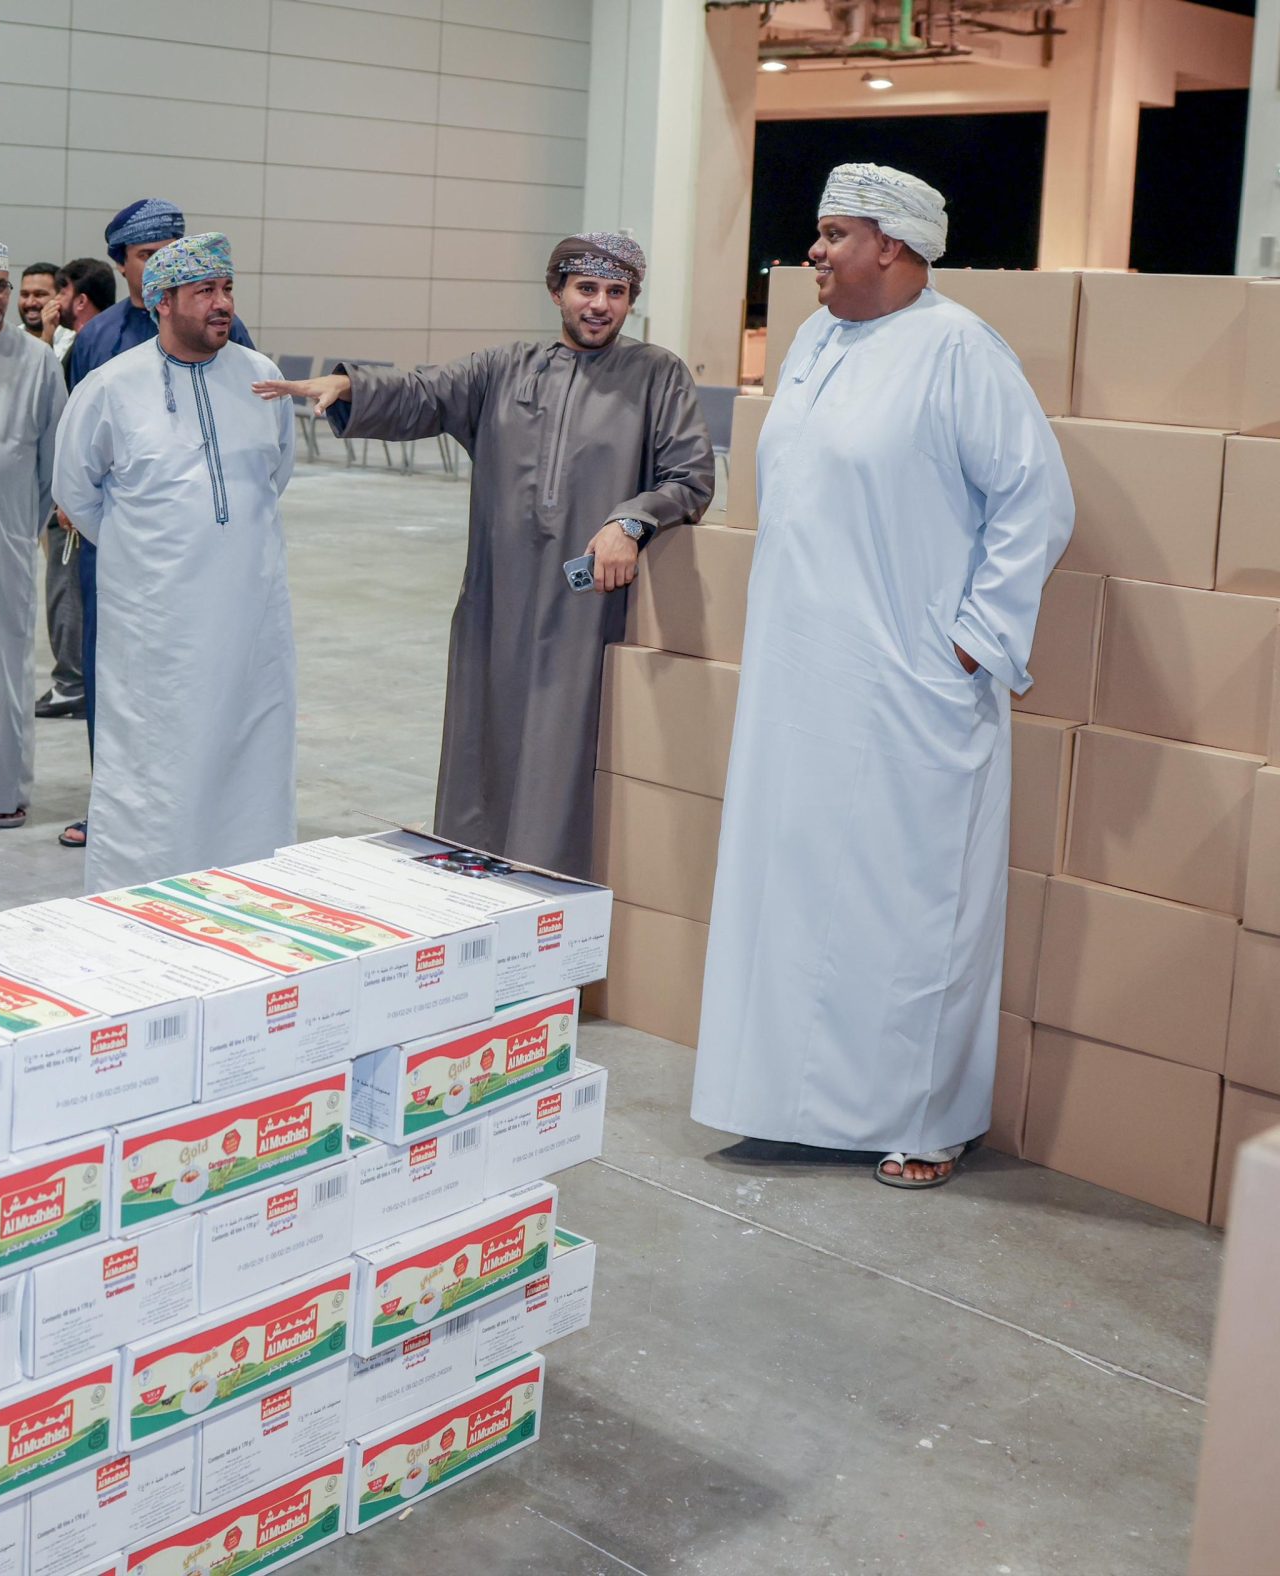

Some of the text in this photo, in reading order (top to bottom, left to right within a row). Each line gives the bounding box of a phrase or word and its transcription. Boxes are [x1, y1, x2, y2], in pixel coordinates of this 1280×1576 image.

[508, 1027, 546, 1055] المدهش
[448, 1058, 470, 1081] Gold
[259, 1104, 309, 1136] المدهش
[179, 1139, 209, 1165] Gold
[4, 1181, 62, 1218] المدهش
[483, 1228, 523, 1259] المدهش
[267, 1306, 316, 1342] المدهش
[12, 1403, 71, 1443] المدهش
[469, 1398, 510, 1431] المدهش
[406, 1440, 430, 1465] Gold
[260, 1492, 309, 1529] المدهش
